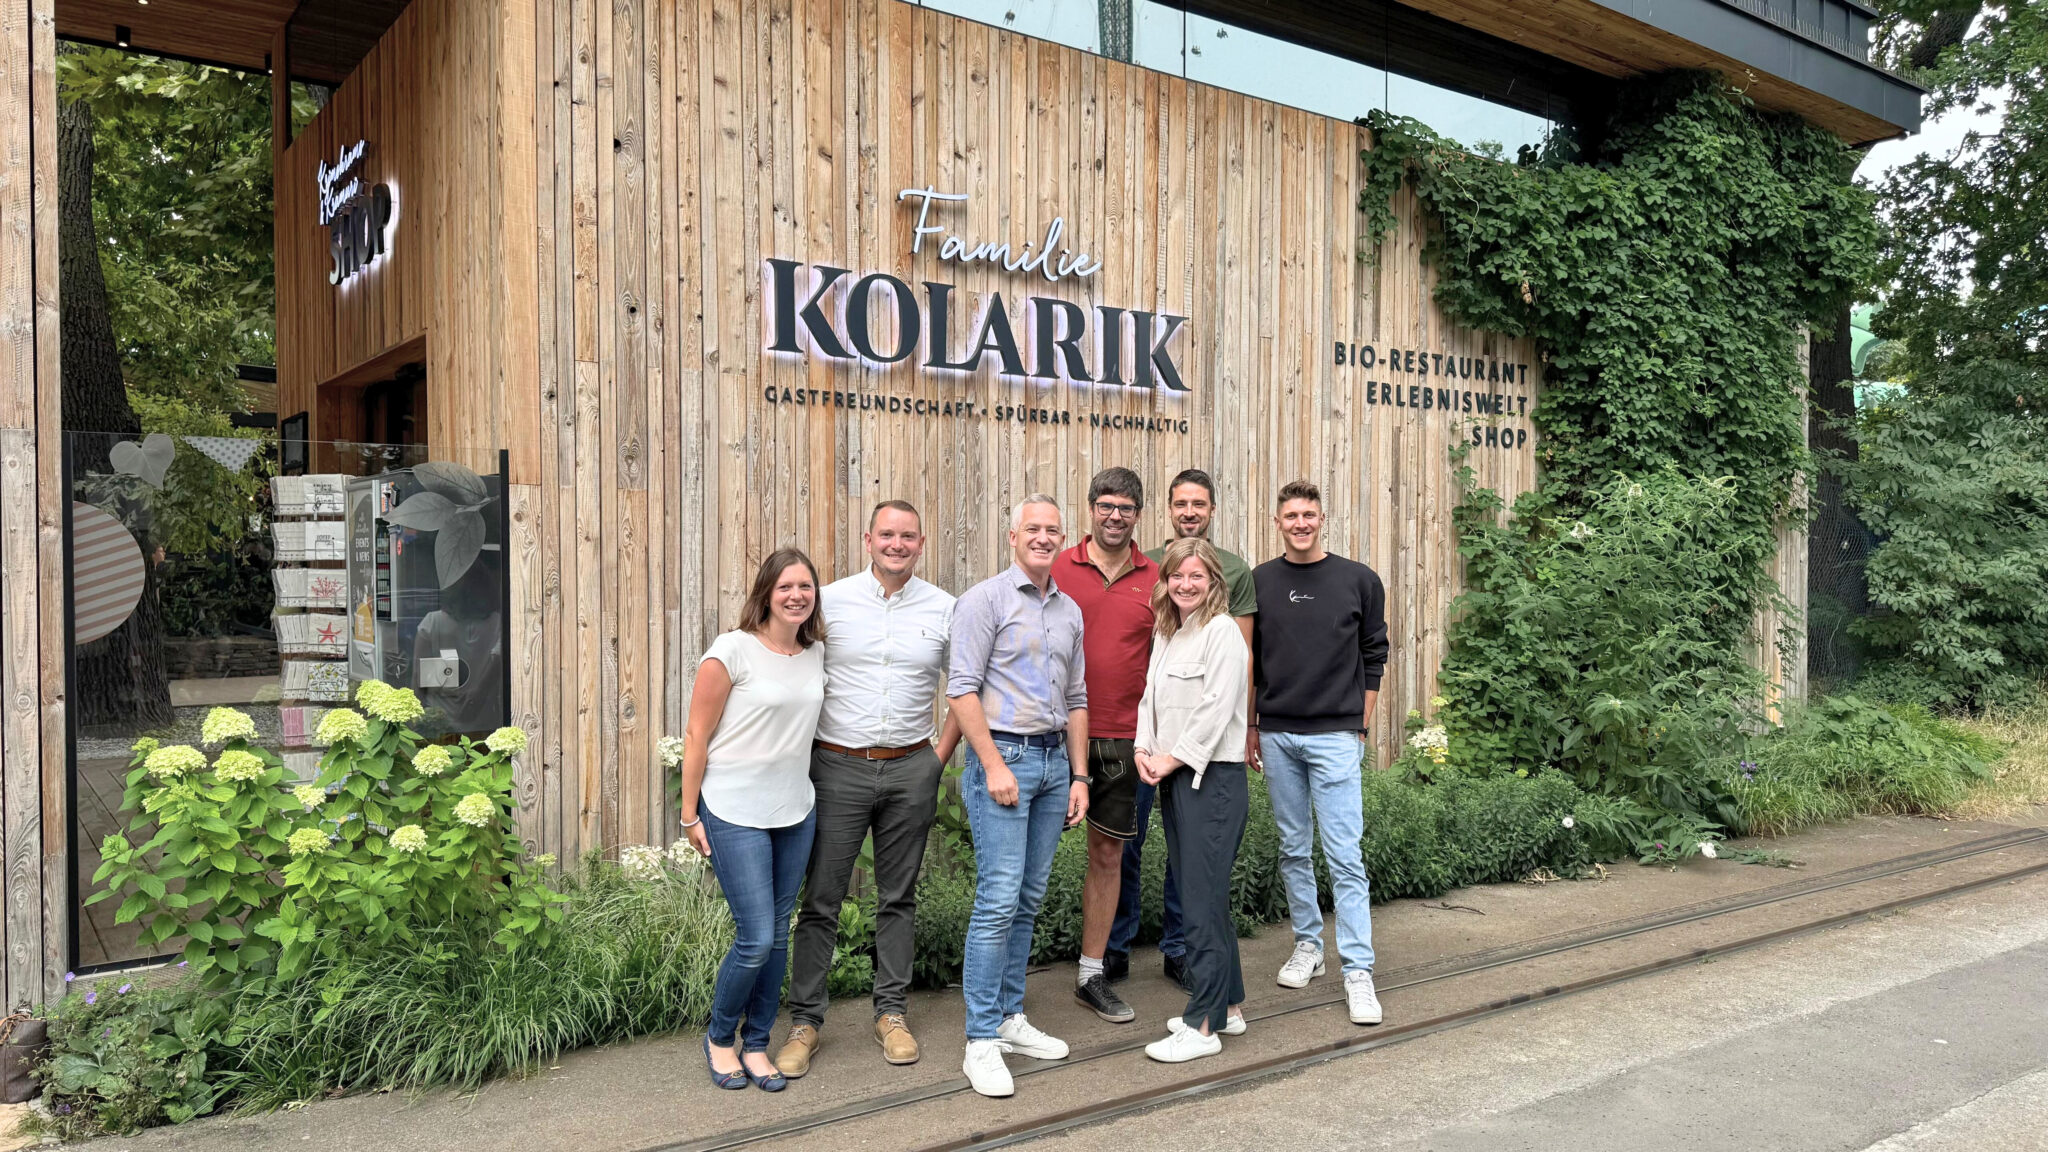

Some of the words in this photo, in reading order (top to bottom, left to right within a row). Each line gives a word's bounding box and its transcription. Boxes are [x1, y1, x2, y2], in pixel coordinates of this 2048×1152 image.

[329, 183, 392, 286] SHOP
[899, 185, 1101, 282] Familie
[766, 258, 1192, 391] KOLARIK
[1334, 341, 1527, 385] BIO-RESTAURANT
[764, 385, 975, 418] GASTFREUNDSCHAFT
[995, 404, 1070, 425] SPÜRBAR
[1090, 413, 1188, 434] NACHHALTIG
[1366, 381, 1527, 417] ERLEBNISWELT
[1472, 425, 1527, 449] SHOP
